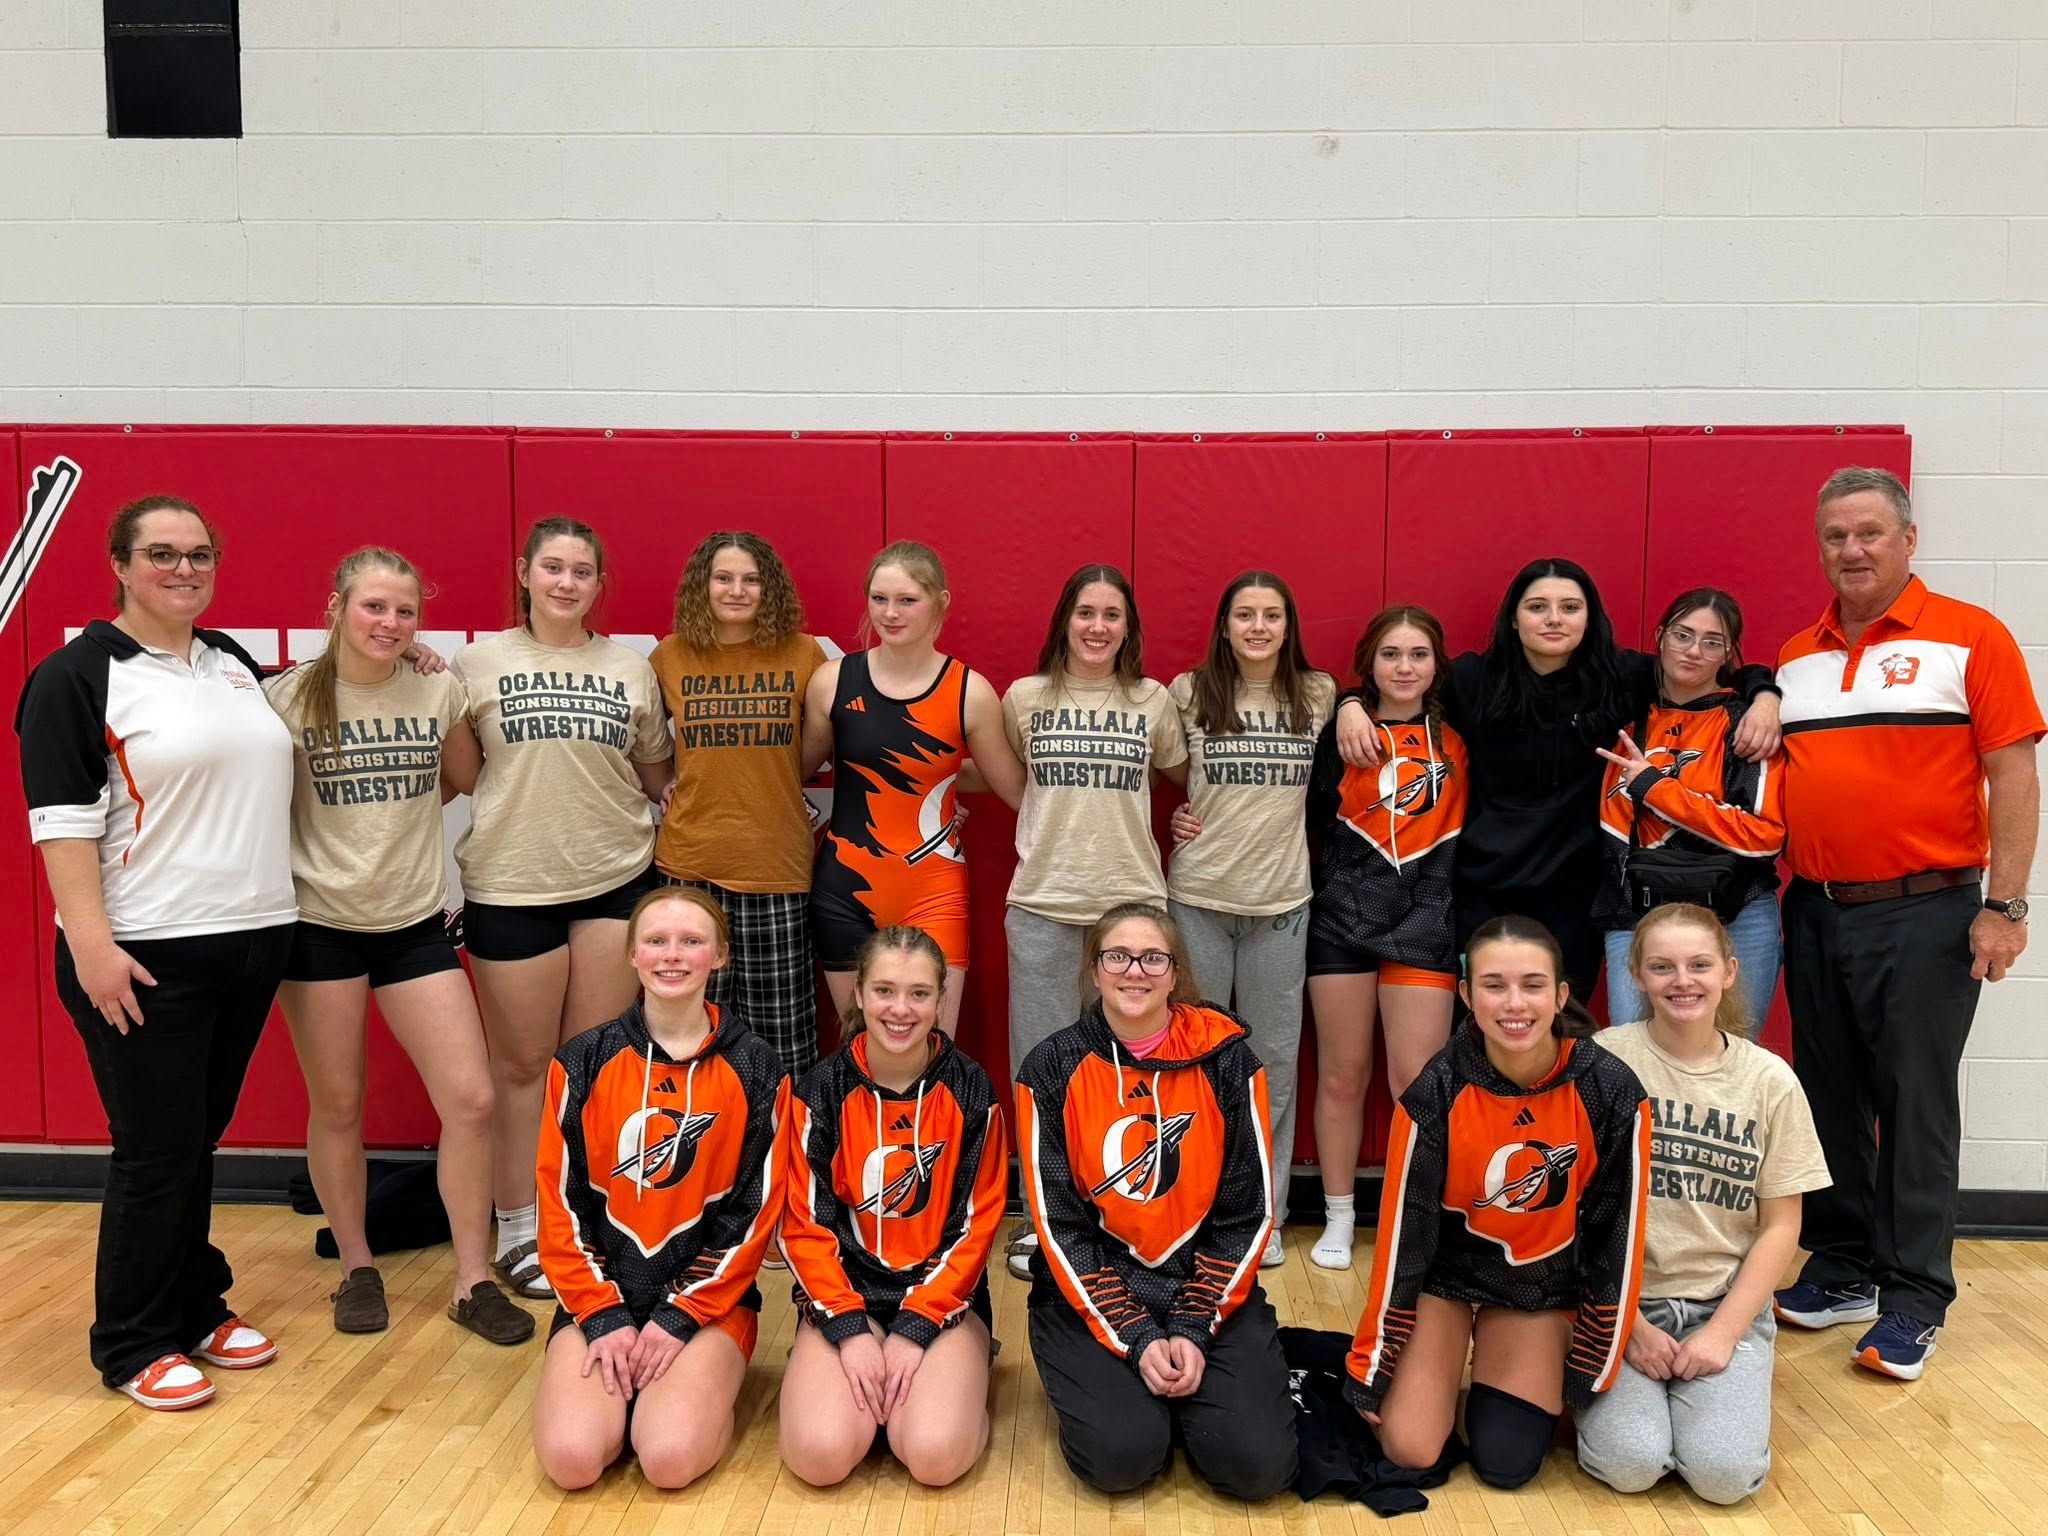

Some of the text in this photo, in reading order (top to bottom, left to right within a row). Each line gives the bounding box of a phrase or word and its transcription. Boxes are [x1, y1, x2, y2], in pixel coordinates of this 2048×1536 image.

[499, 671, 628, 702] OGALLALA
[681, 671, 795, 697] OGALLALA
[503, 696, 628, 718] CONSISTENCY
[688, 699, 787, 717] RESILIENCE
[500, 715, 628, 750] WRESTLING
[680, 722, 794, 749] WRESTLING
[1031, 708, 1148, 738] OGALLALA
[312, 751, 439, 773] CONSISTENCY
[1031, 739, 1144, 759] CONSISTENCY
[313, 769, 436, 806] WRESTLING
[1031, 761, 1143, 792] WRESTLING
[1202, 761, 1312, 787] WRESTLIN
[1649, 1096, 1757, 1149] ALLALA
[1651, 1138, 1756, 1175] SISTENCY
[1650, 1166, 1755, 1212] ESTLING
